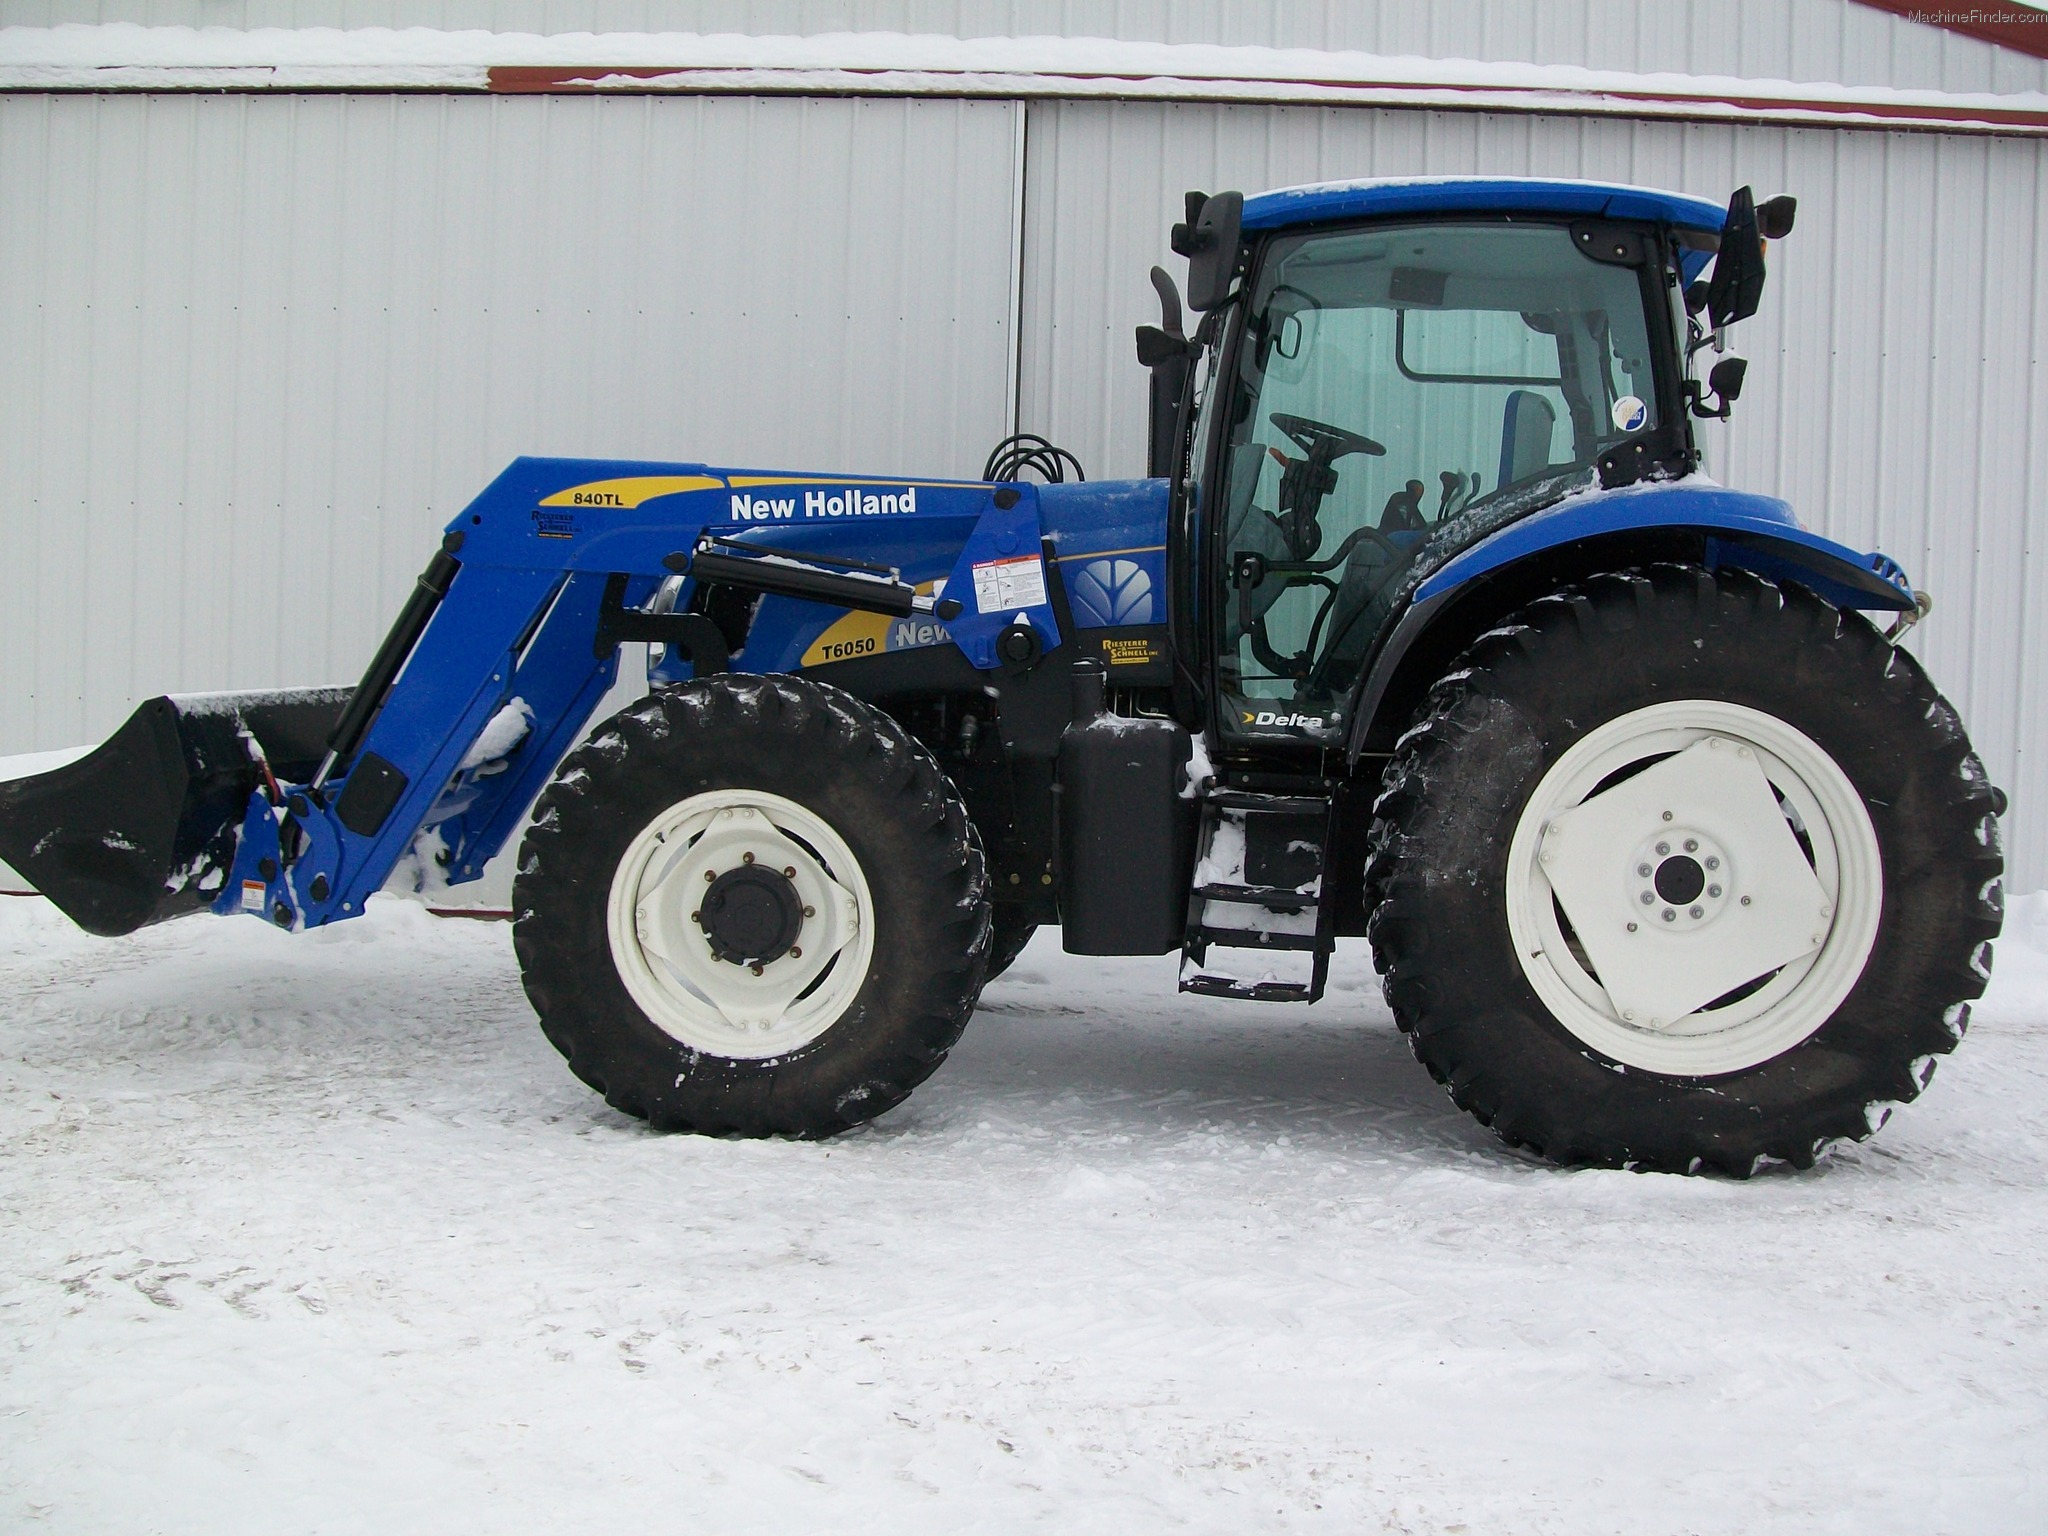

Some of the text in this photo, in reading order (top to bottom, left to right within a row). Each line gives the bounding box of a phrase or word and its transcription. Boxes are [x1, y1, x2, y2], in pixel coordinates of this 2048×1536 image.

[573, 492, 624, 506] 840TL
[731, 486, 916, 521] New Holland
[822, 637, 876, 660] T6050
[1102, 639, 1148, 650] RIESTERER
[1110, 648, 1148, 659] SCHNELL
[1255, 711, 1323, 727] Delta
